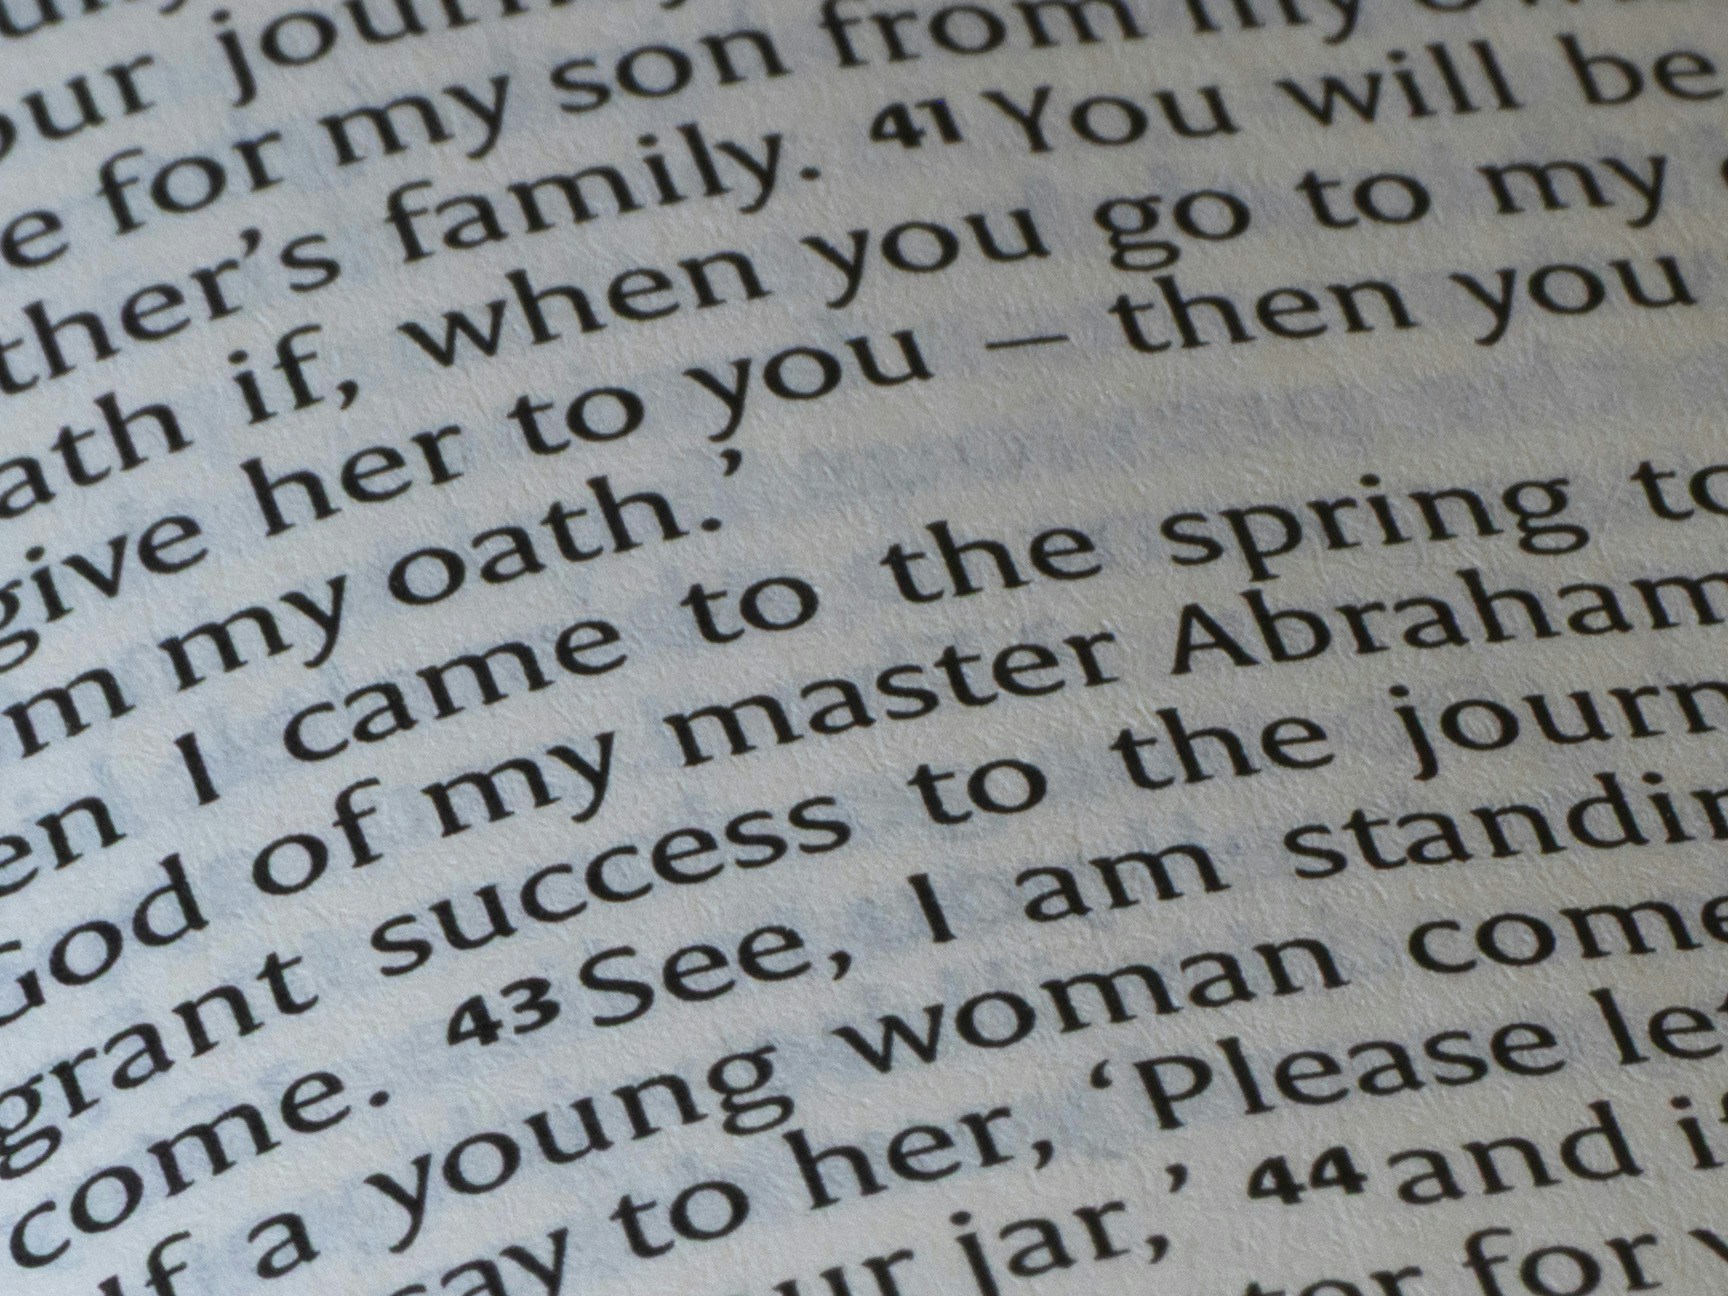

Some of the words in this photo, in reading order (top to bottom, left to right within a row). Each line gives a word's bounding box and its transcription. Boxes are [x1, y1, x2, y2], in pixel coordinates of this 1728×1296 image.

[94, 128, 285, 238] for
[315, 72, 513, 169] my
[547, 26, 793, 117] son
[225, 321, 362, 428] if,
[394, 248, 775, 370] when
[798, 205, 1054, 312] you
[1090, 187, 1254, 275] go
[1292, 168, 1434, 233] to
[1475, 152, 1670, 232] my
[237, 422, 466, 540] her
[504, 384, 648, 459] to
[680, 327, 937, 446] you
[1105, 272, 1422, 357] then
[1446, 253, 1701, 349] you
[155, 572, 349, 694] my
[171, 729, 223, 809] I
[280, 617, 630, 765] came
[677, 573, 822, 647] to
[877, 517, 1105, 607] the
[1157, 471, 1593, 585] spring
[249, 775, 386, 899] of
[418, 729, 617, 841] my
[660, 629, 1122, 770] master
[367, 793, 855, 980] success
[904, 756, 1050, 829] to
[1106, 705, 1338, 794] the
[245, 1210, 323, 1282] a
[361, 1041, 797, 1256] young
[827, 935, 1354, 1076] woman
[607, 1177, 753, 1262] to
[779, 1103, 1057, 1213] her,
